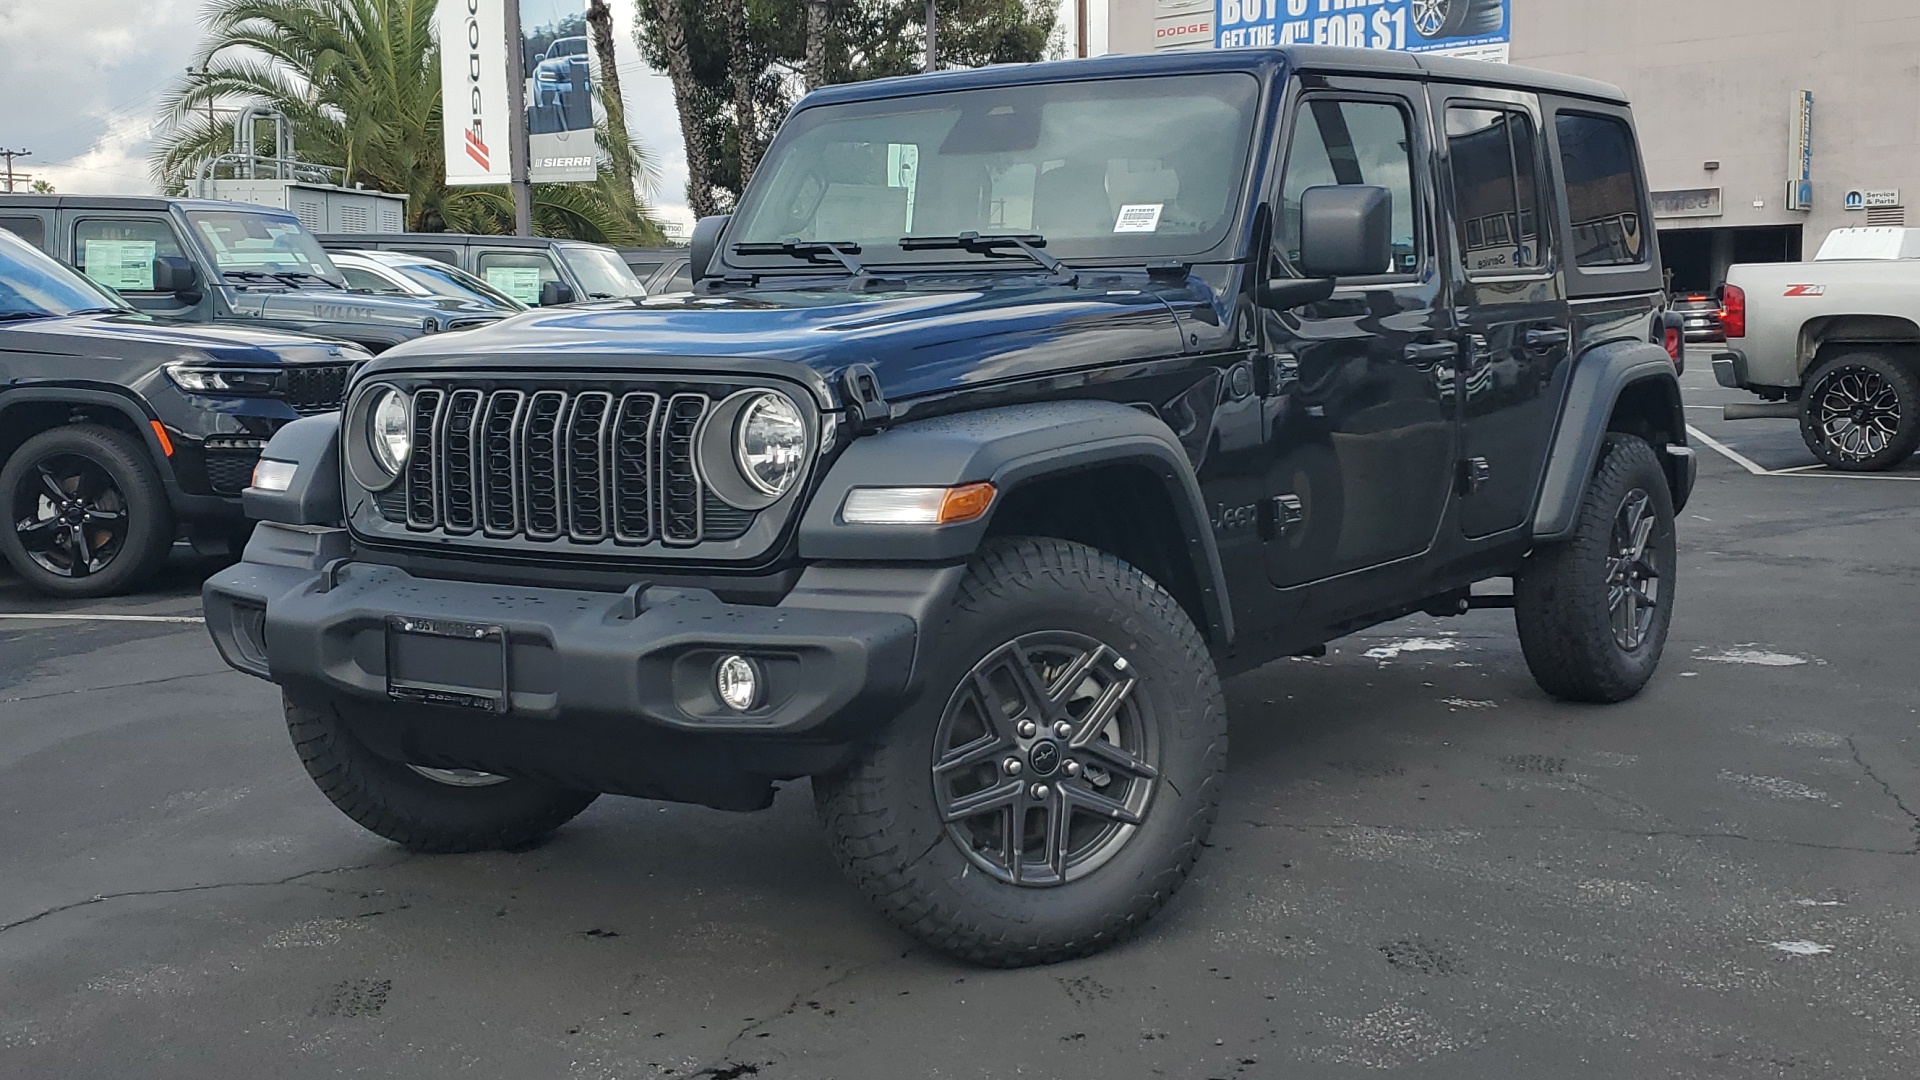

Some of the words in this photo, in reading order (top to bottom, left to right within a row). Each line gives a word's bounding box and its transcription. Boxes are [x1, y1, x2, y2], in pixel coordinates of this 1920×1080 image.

[1157, 23, 1209, 38] DODGE
[1221, 28, 1246, 48] GET
[1248, 24, 1275, 46] THE
[1313, 13, 1366, 48] FOR
[1371, 6, 1406, 50] $1
[467, 0, 483, 145] DODGE
[543, 156, 592, 168] SIERRA
[413, 619, 431, 631] LOS
